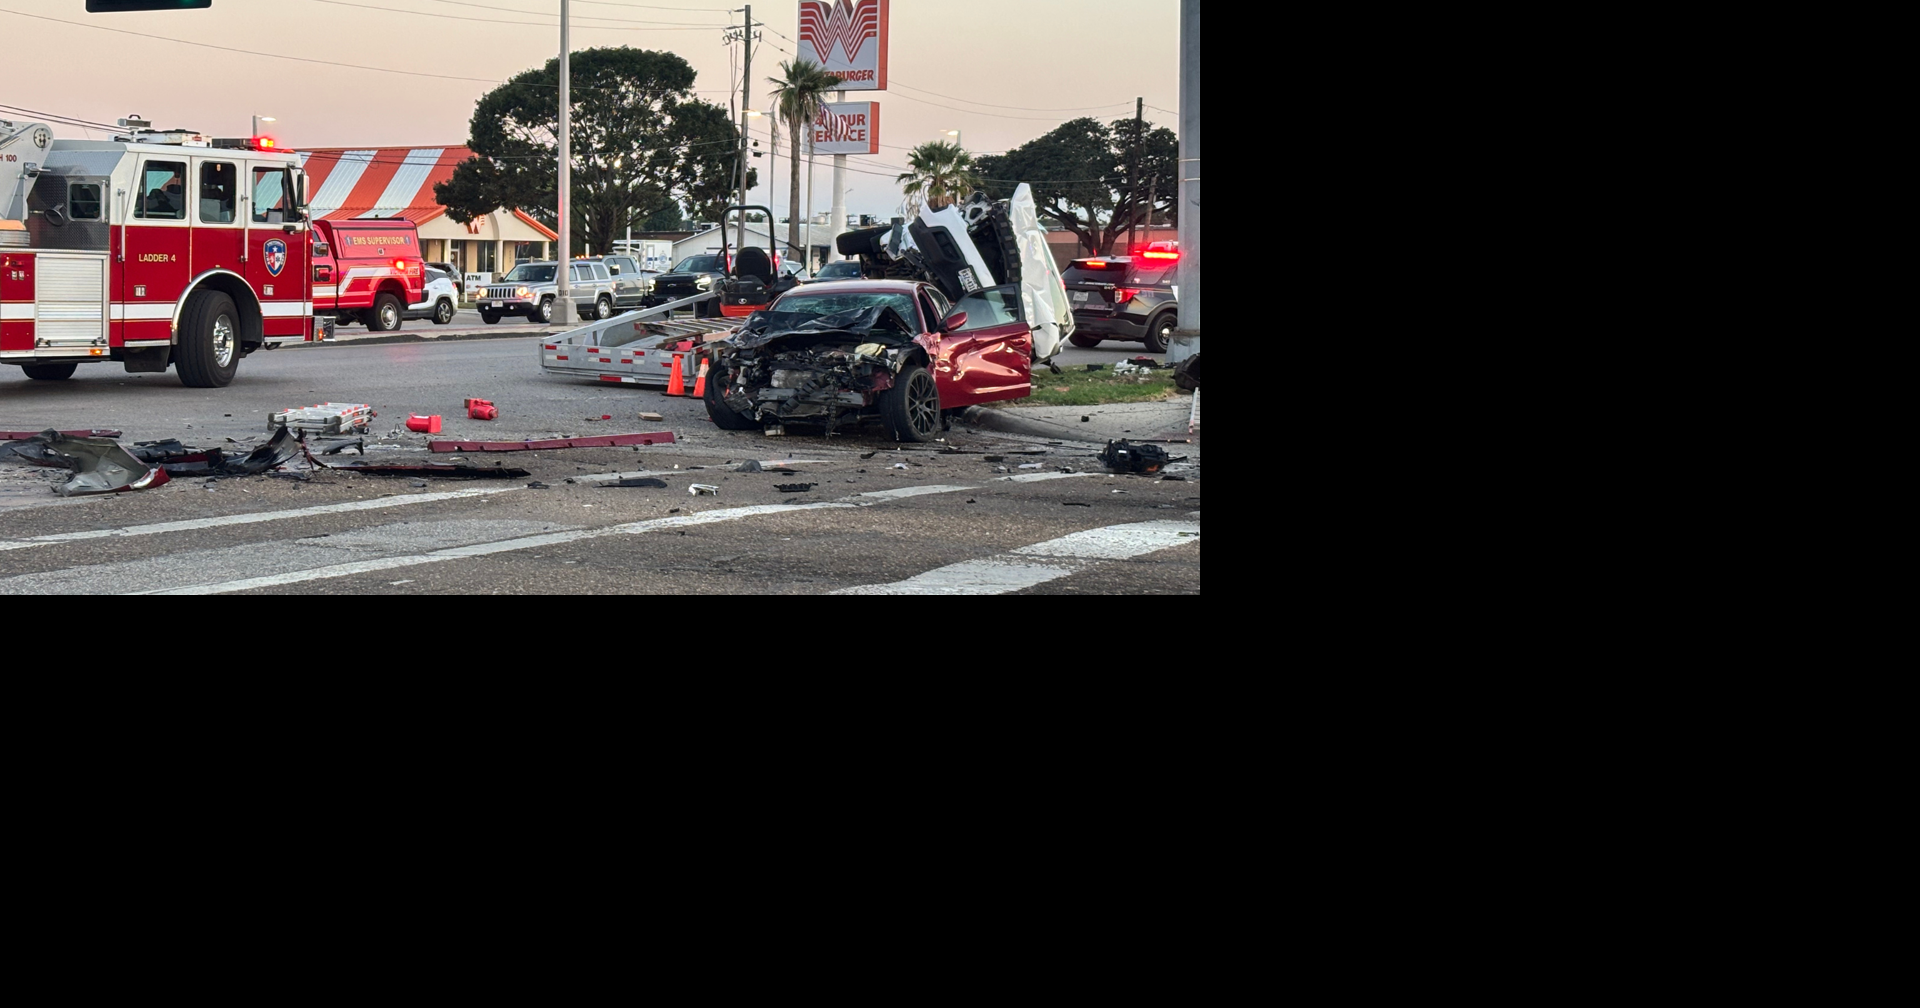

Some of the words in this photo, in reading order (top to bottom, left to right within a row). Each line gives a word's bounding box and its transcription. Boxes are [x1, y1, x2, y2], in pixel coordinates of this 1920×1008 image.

[5, 153, 17, 163] 100
[352, 236, 366, 245] EMS
[366, 236, 405, 245] SUPERVISOR
[138, 253, 169, 262] LADDER
[170, 254, 176, 262] 4
